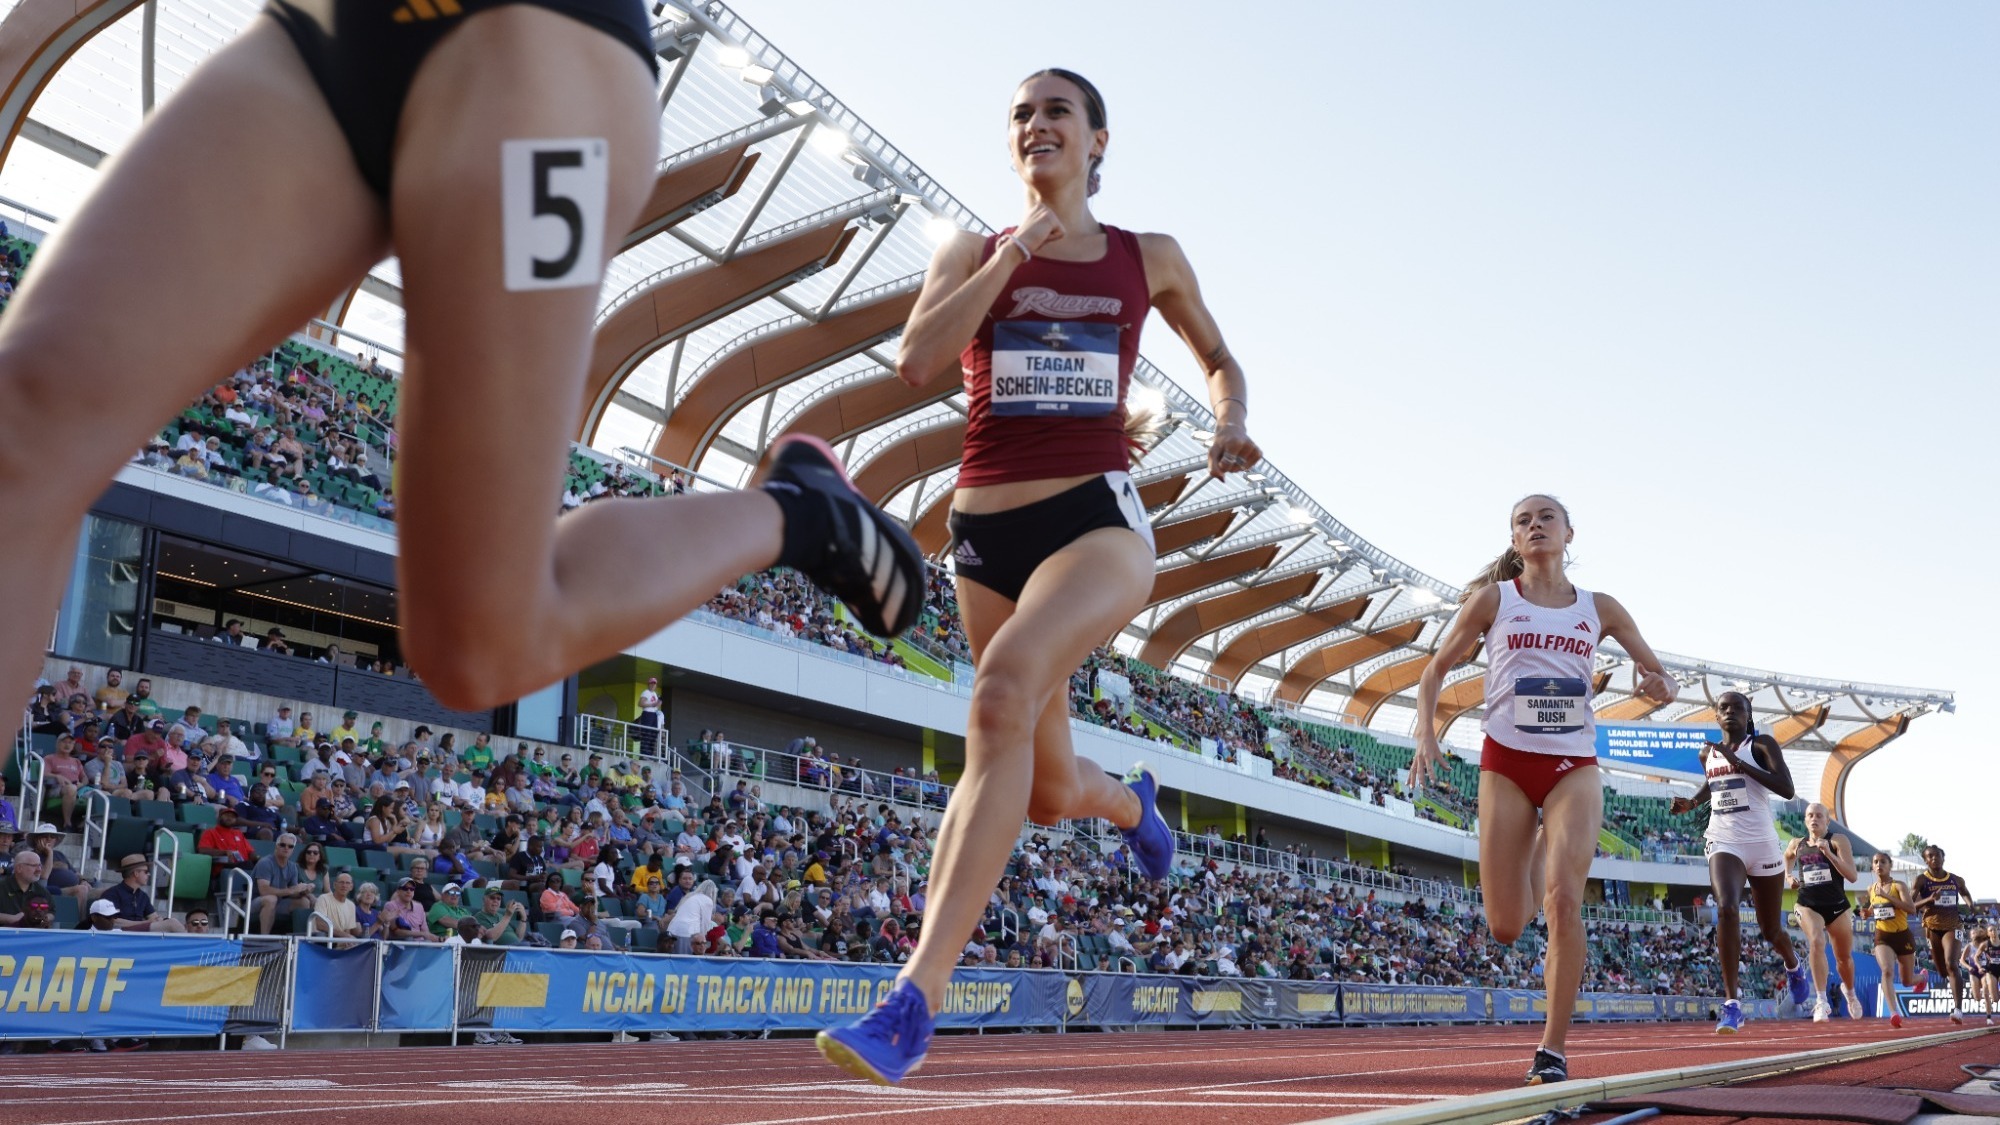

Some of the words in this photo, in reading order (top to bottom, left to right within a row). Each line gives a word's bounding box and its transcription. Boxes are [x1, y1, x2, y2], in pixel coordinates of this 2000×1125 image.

[531, 150, 584, 280] 5
[1007, 286, 1122, 319] RIDER
[1026, 356, 1085, 372] TEAGAN
[996, 376, 1113, 397] SCHEIN-BECKER
[1510, 615, 1531, 623] ACC
[1507, 632, 1594, 660] WOLFPACK
[1527, 699, 1575, 709] SAMANTHA
[1537, 711, 1566, 724] BUSH
[1607, 729, 1637, 738] LEADER
[1659, 731, 1675, 739] MAY
[1689, 732, 1706, 740] HER
[1608, 739, 1648, 748] SHOULDER
[1650, 740, 1660, 748] AS
[1661, 741, 1674, 749] WE
[1675, 741, 1707, 749] APPROA
[1609, 748, 1632, 757] FINAL
[1632, 749, 1654, 757] BELL.
[582, 971, 656, 1013] NCAA
[660, 974, 689, 1014] DI
[696, 975, 770, 1014] TRACK
[771, 978, 814, 1014] AND
[819, 978, 872, 1014] FIELD
[1132, 986, 1179, 1013] #NCAATF
[1930, 989, 1954, 999] TRAC
